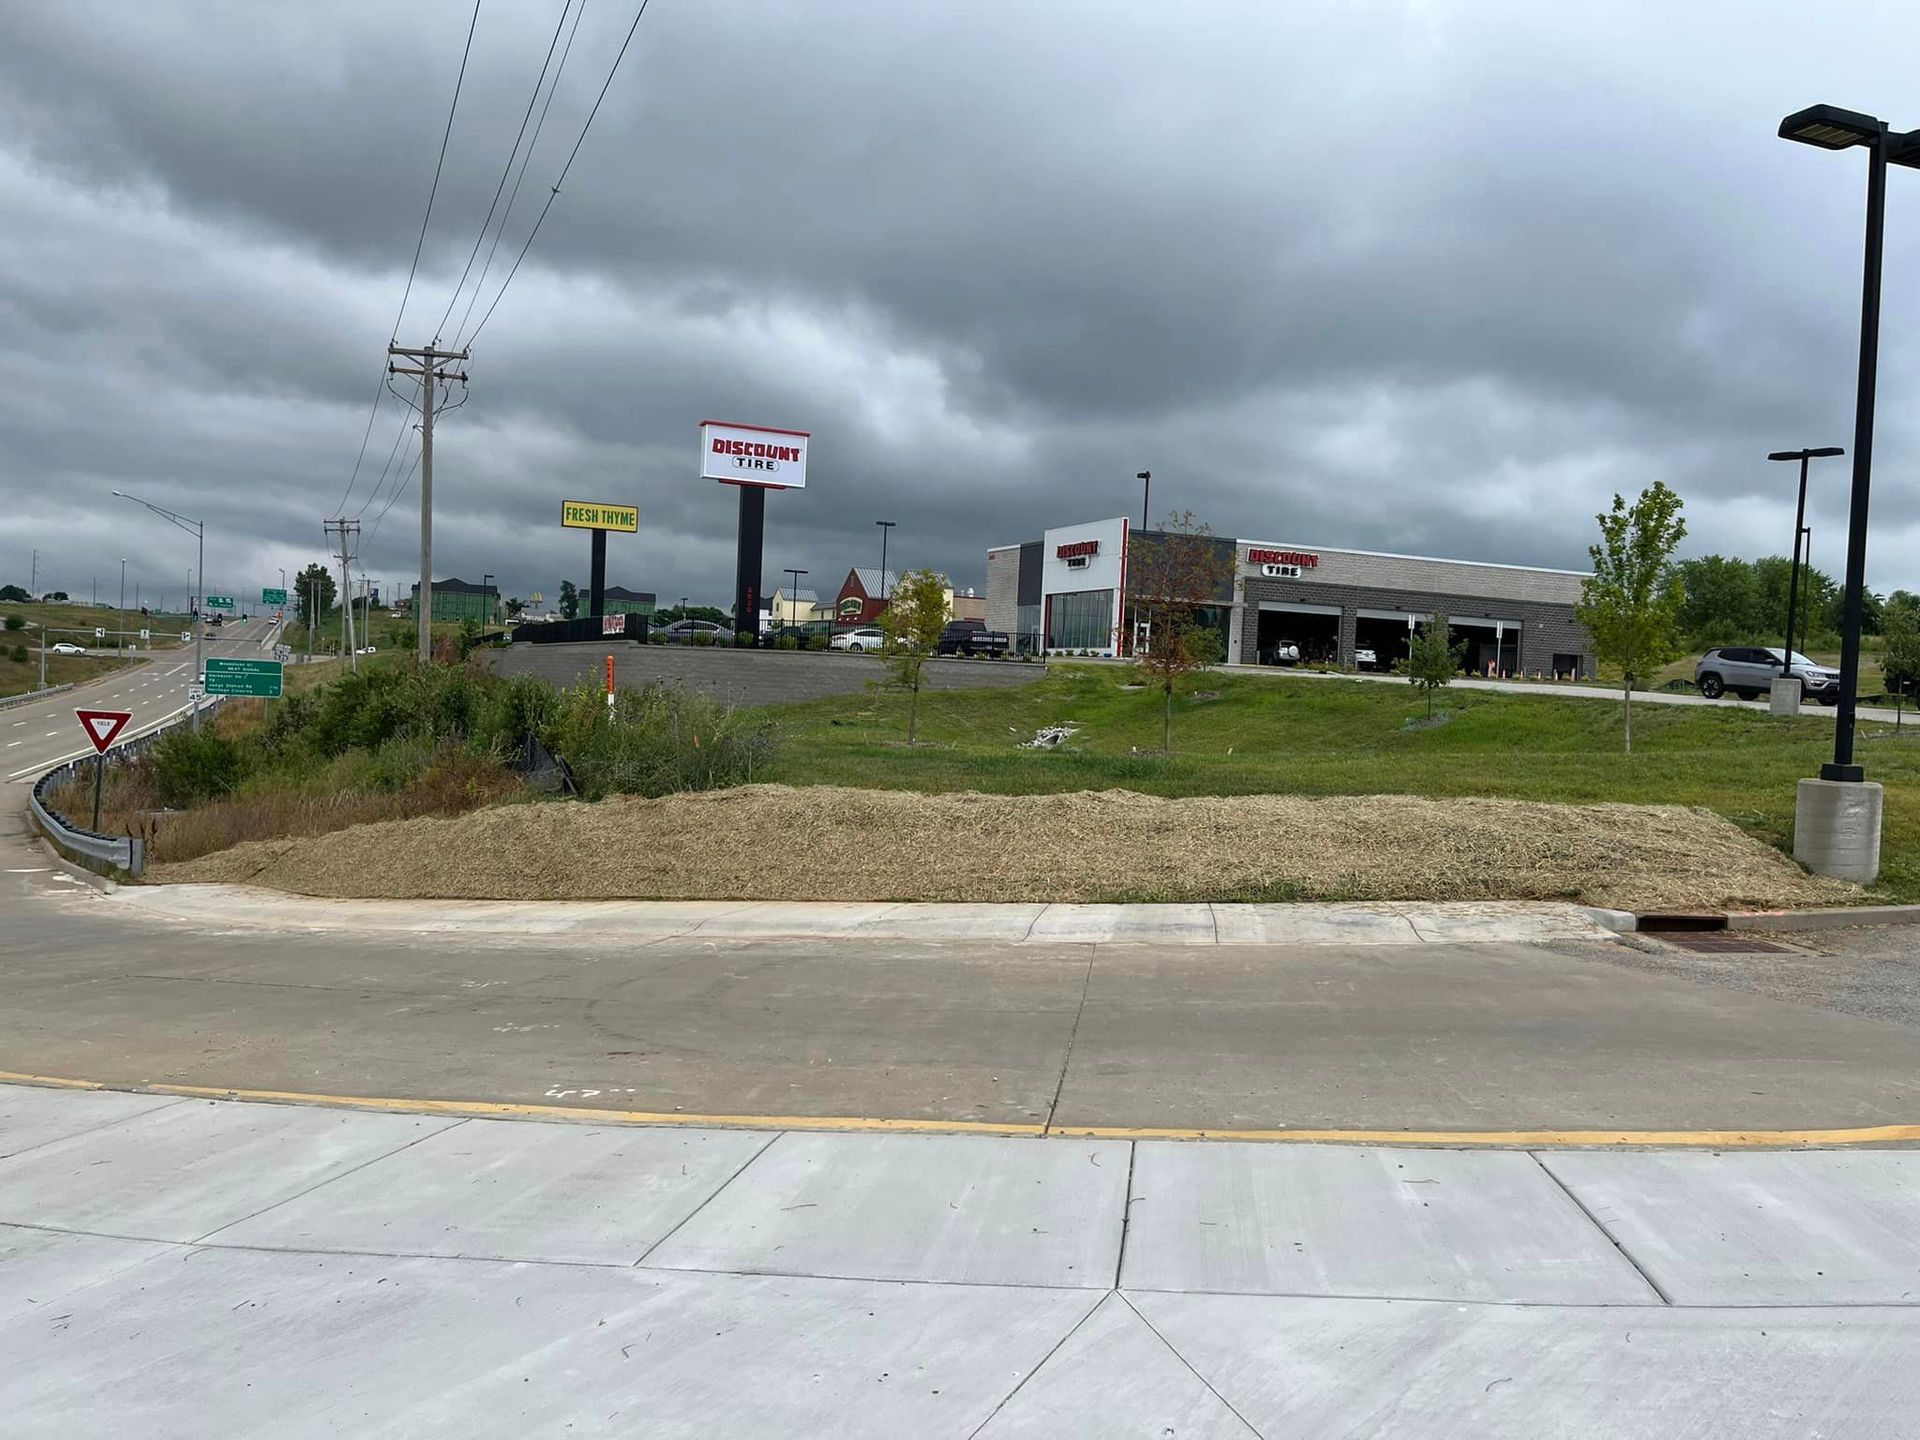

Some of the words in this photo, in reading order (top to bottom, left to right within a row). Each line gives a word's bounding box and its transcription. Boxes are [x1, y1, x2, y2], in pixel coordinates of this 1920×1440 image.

[712, 438, 800, 462] DISCOUNT
[736, 457, 775, 470] TIRE
[566, 506, 599, 523] FRESH
[601, 509, 636, 526] THYME
[1056, 540, 1099, 559] DISCOUNT
[1248, 548, 1319, 568] DISCOUNT
[1266, 565, 1299, 577] TIRE
